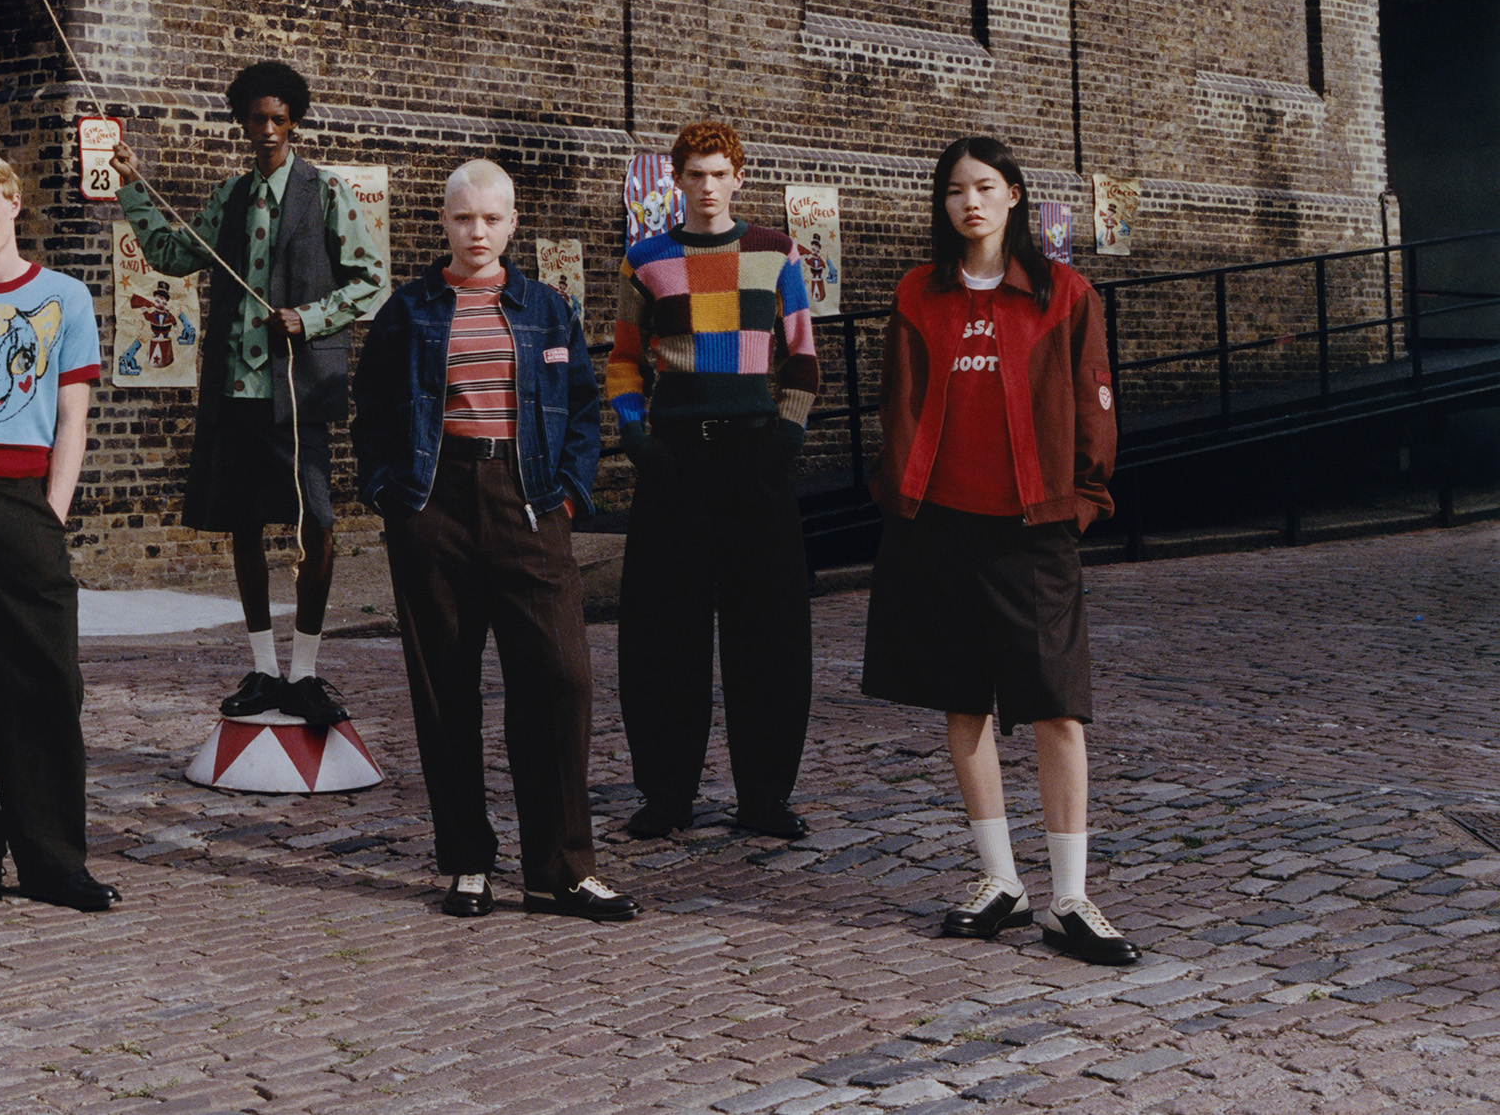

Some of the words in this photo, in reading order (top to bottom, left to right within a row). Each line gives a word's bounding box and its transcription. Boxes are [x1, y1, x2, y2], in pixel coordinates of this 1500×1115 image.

[95, 157, 105, 166] SEP
[90, 169, 110, 191] 23
[789, 196, 811, 216] CUTIE
[811, 201, 836, 221] CIRCUS
[119, 233, 140, 258] CUT
[120, 260, 140, 273] AND
